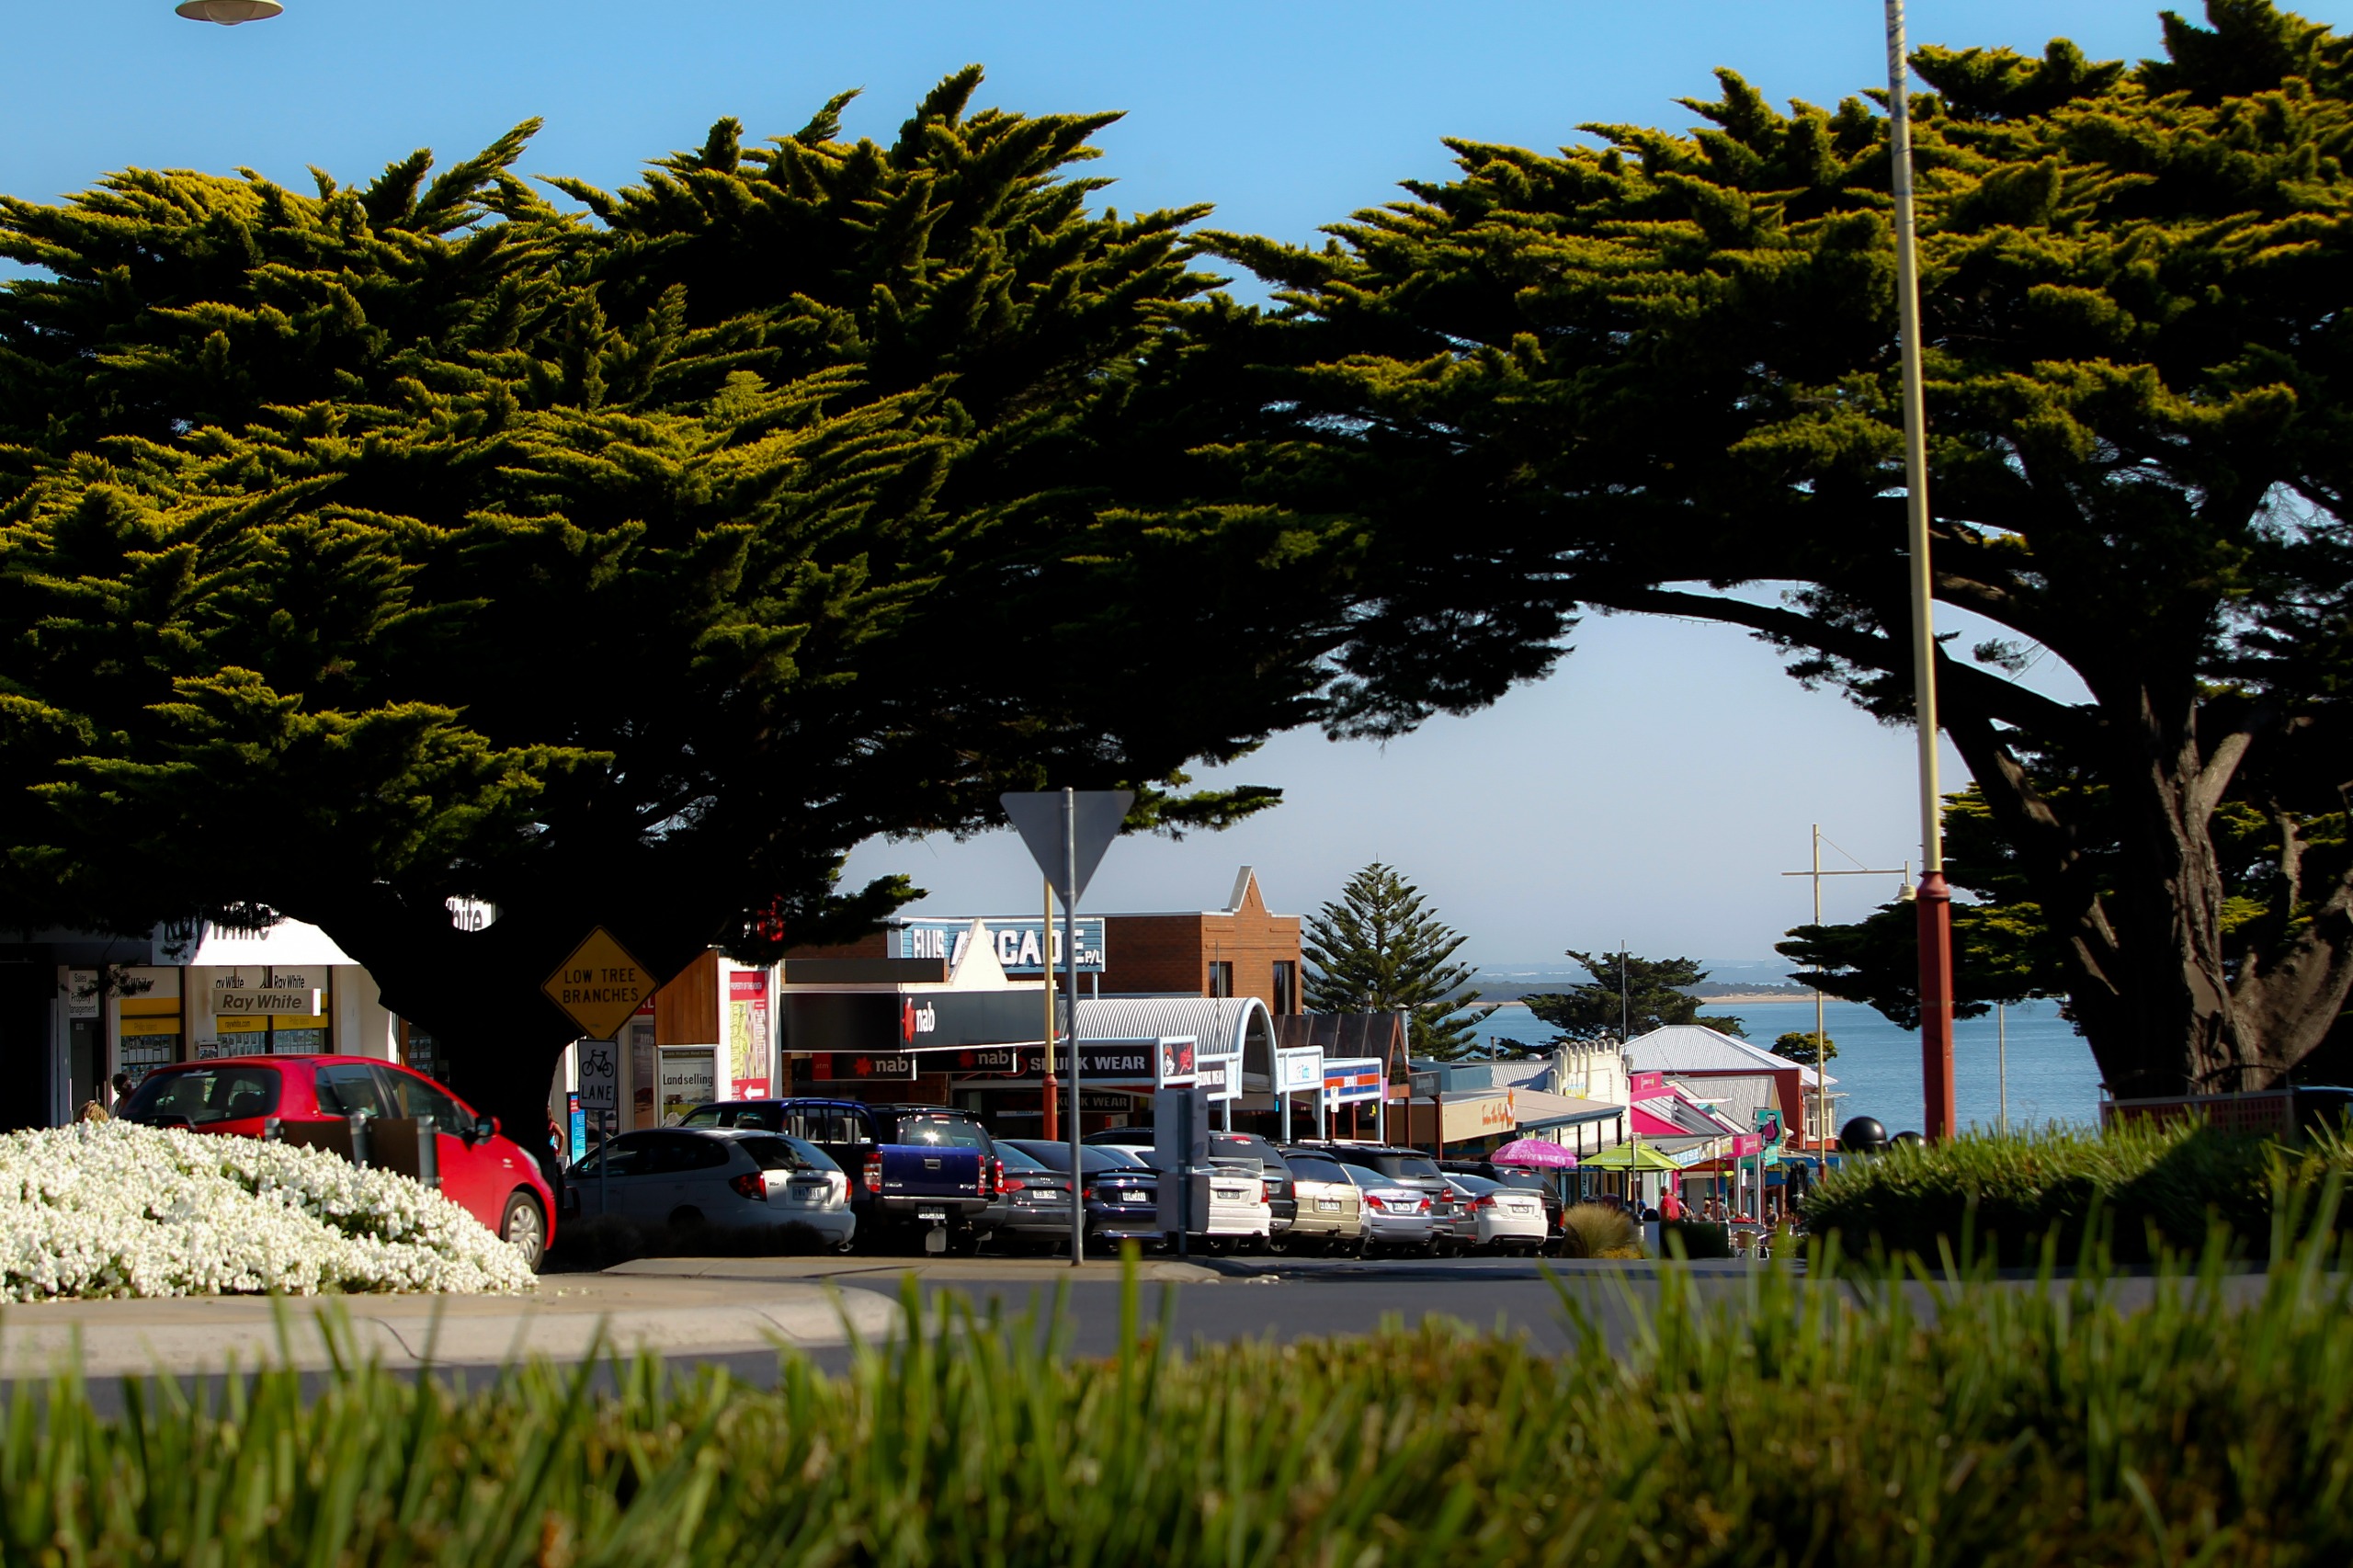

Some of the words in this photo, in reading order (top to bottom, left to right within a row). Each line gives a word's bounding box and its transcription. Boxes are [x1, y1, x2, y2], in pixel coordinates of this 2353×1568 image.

[74, 974, 87, 983] Sales
[274, 975, 287, 988] Ray
[287, 975, 305, 988] White
[564, 970, 593, 983] LOW
[601, 968, 636, 983] TREE
[223, 994, 255, 1011] Ray
[257, 994, 302, 1008] White
[563, 988, 639, 1004] BRANCHES
[915, 1000, 936, 1032] nab
[875, 1056, 909, 1073] nab
[977, 1050, 1009, 1064] nab
[1094, 1056, 1145, 1070] WEAR
[582, 1085, 612, 1100] LANE
[1093, 1096, 1127, 1107] WEAR
